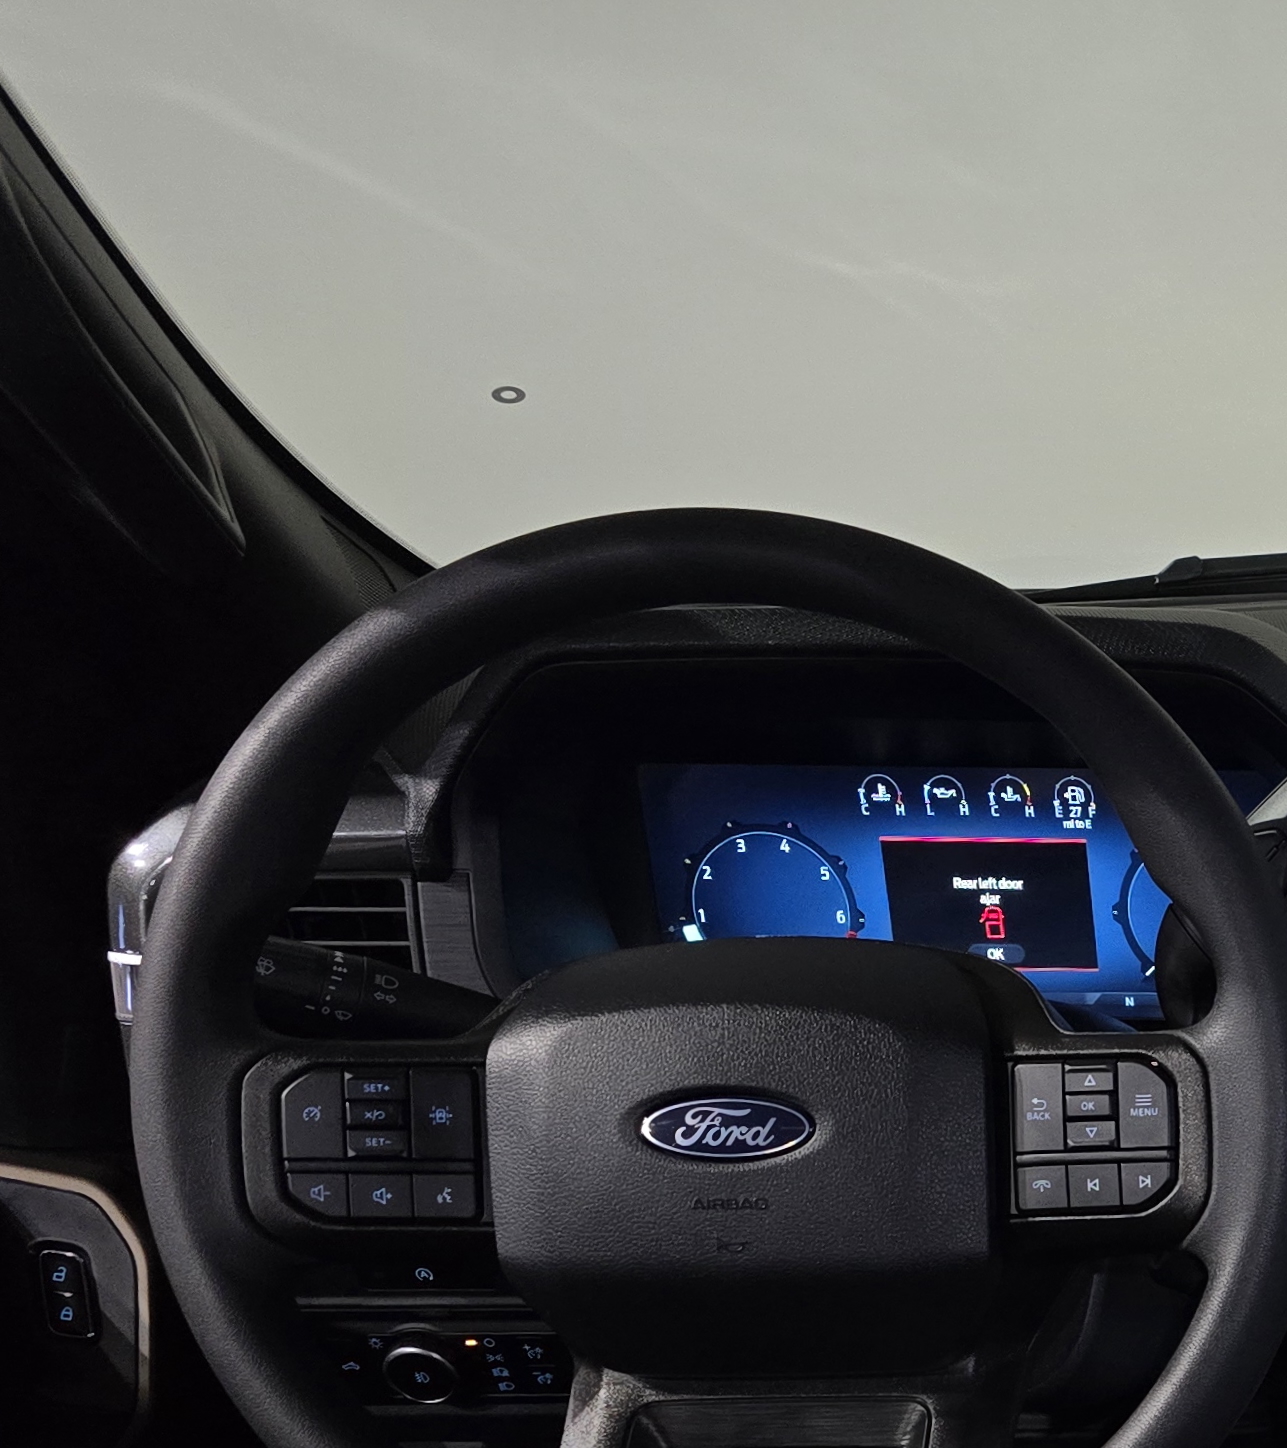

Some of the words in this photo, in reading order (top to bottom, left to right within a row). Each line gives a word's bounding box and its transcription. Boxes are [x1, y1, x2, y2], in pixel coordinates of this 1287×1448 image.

[861, 803, 870, 816] C
[895, 803, 906, 816] H
[926, 803, 935, 816] L
[959, 803, 970, 816] H
[990, 804, 1000, 817] C
[1024, 805, 1036, 818] H
[1055, 805, 1064, 818] E
[1069, 806, 1082, 818] 27
[1088, 806, 1096, 818] F
[1085, 819, 1092, 829] E
[736, 838, 746, 853] 3
[779, 839, 791, 853] 4
[702, 865, 712, 880] 2
[820, 866, 830, 881] 5
[952, 876, 977, 889] Rear
[978, 876, 998, 889] left
[998, 877, 1024, 890] door
[979, 892, 1001, 906] ajar
[698, 908, 706, 923] 1
[836, 910, 846, 924] 6
[986, 947, 1005, 961] OK
[1125, 996, 1135, 1007] N
[363, 1083, 391, 1093] SET+
[1080, 1101, 1095, 1111] OK
[1130, 1107, 1159, 1117] MENU
[1026, 1112, 1051, 1121] BACK
[674, 1105, 778, 1147] Ford
[691, 1197, 768, 1210] AIRBAG
